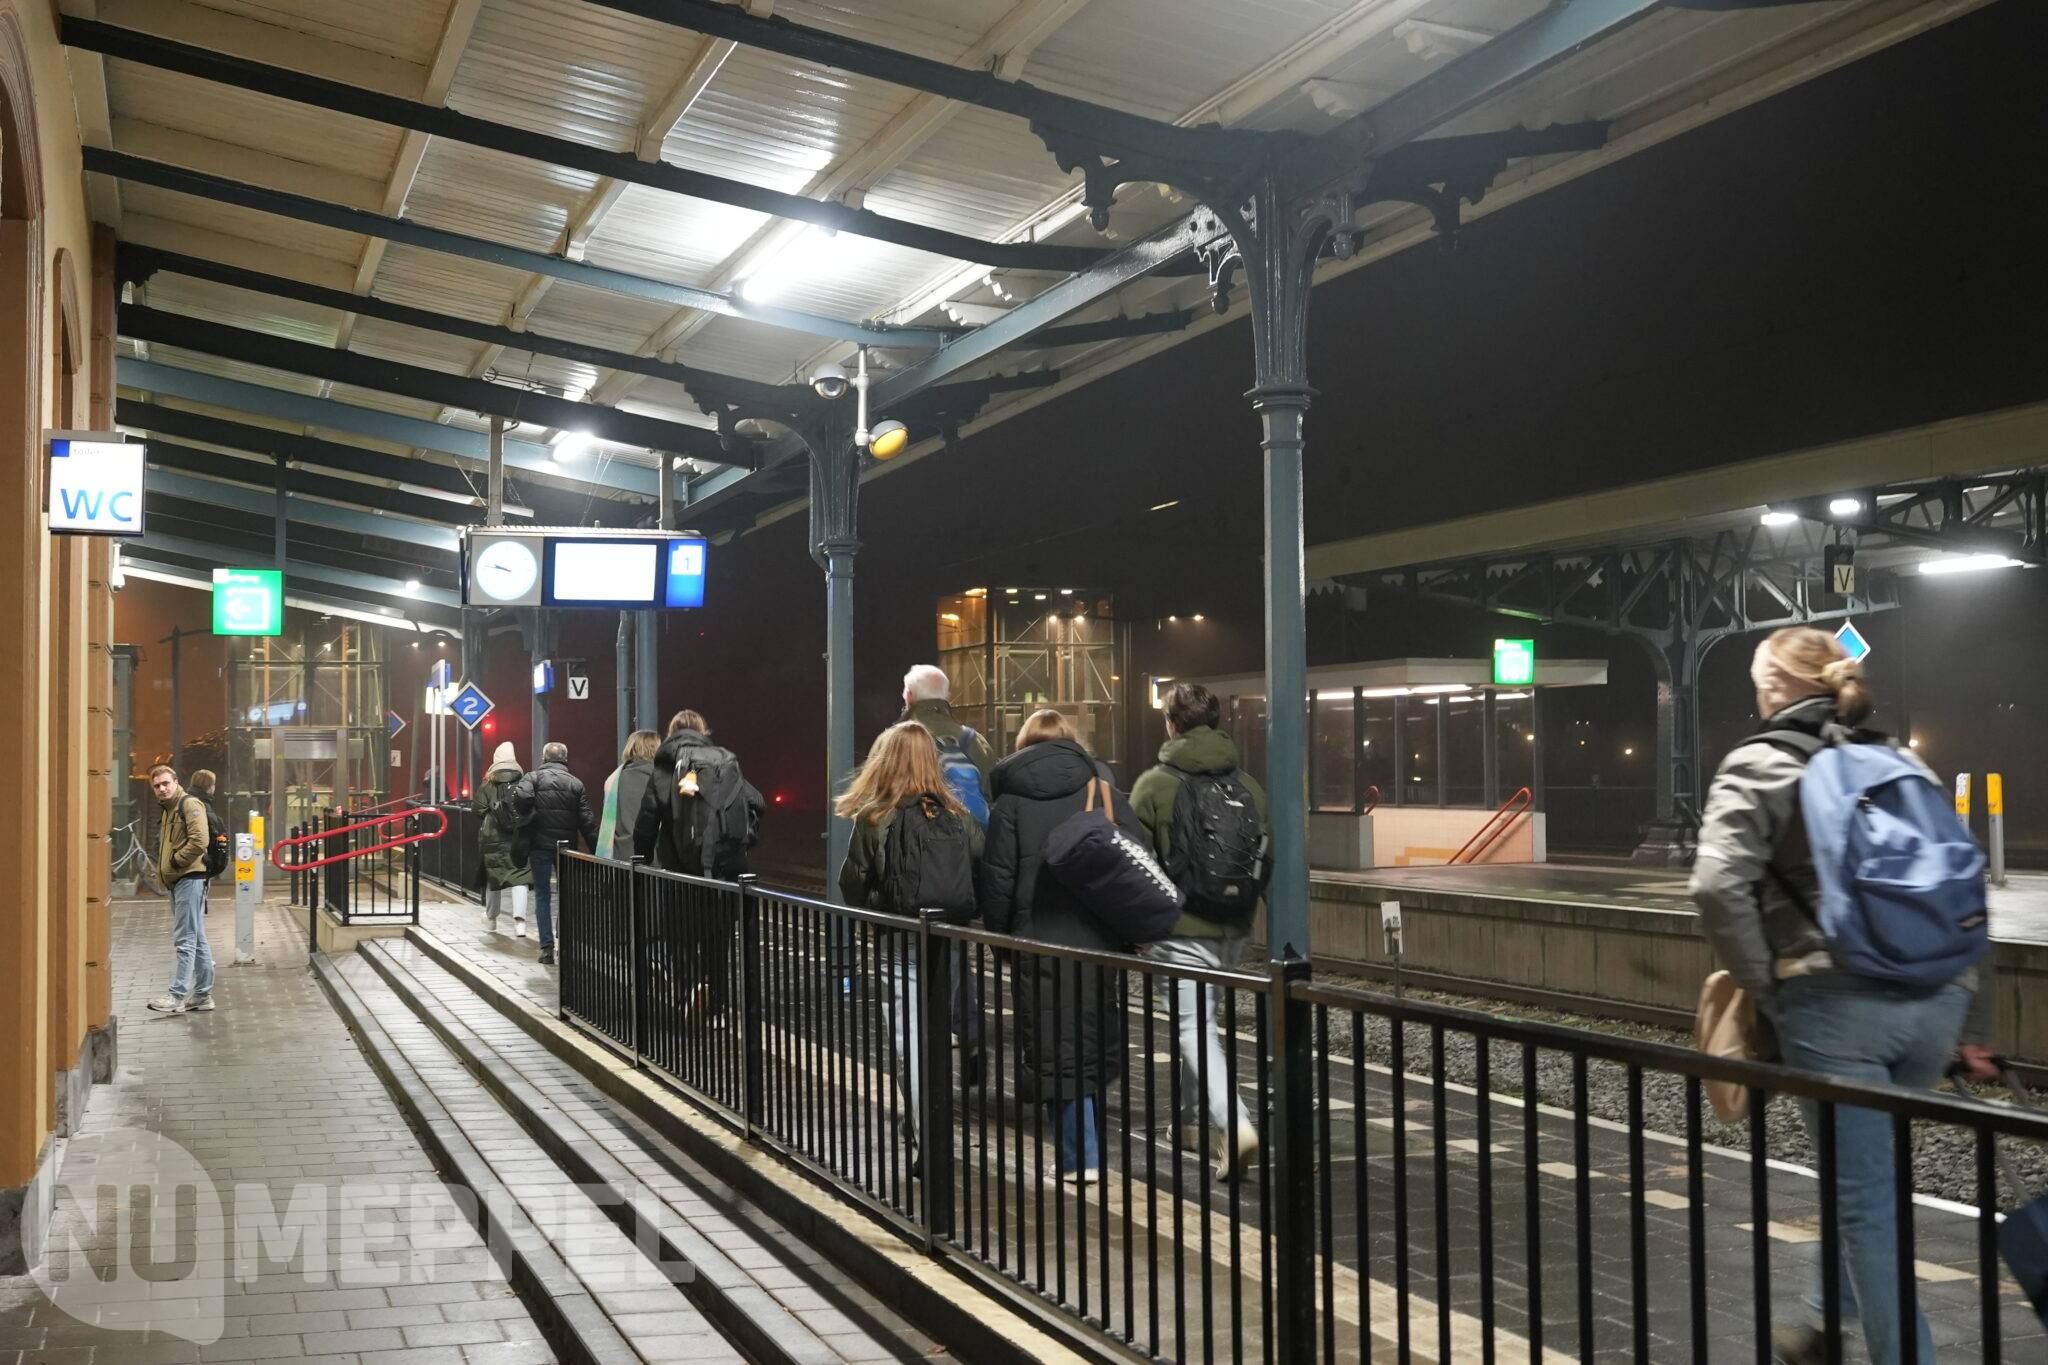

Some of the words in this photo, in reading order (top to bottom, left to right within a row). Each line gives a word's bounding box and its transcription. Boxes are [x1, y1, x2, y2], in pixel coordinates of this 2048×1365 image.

[60, 488, 133, 522] WC
[1837, 567, 1851, 591] V
[571, 679, 587, 697] V
[462, 696, 479, 715] 2
